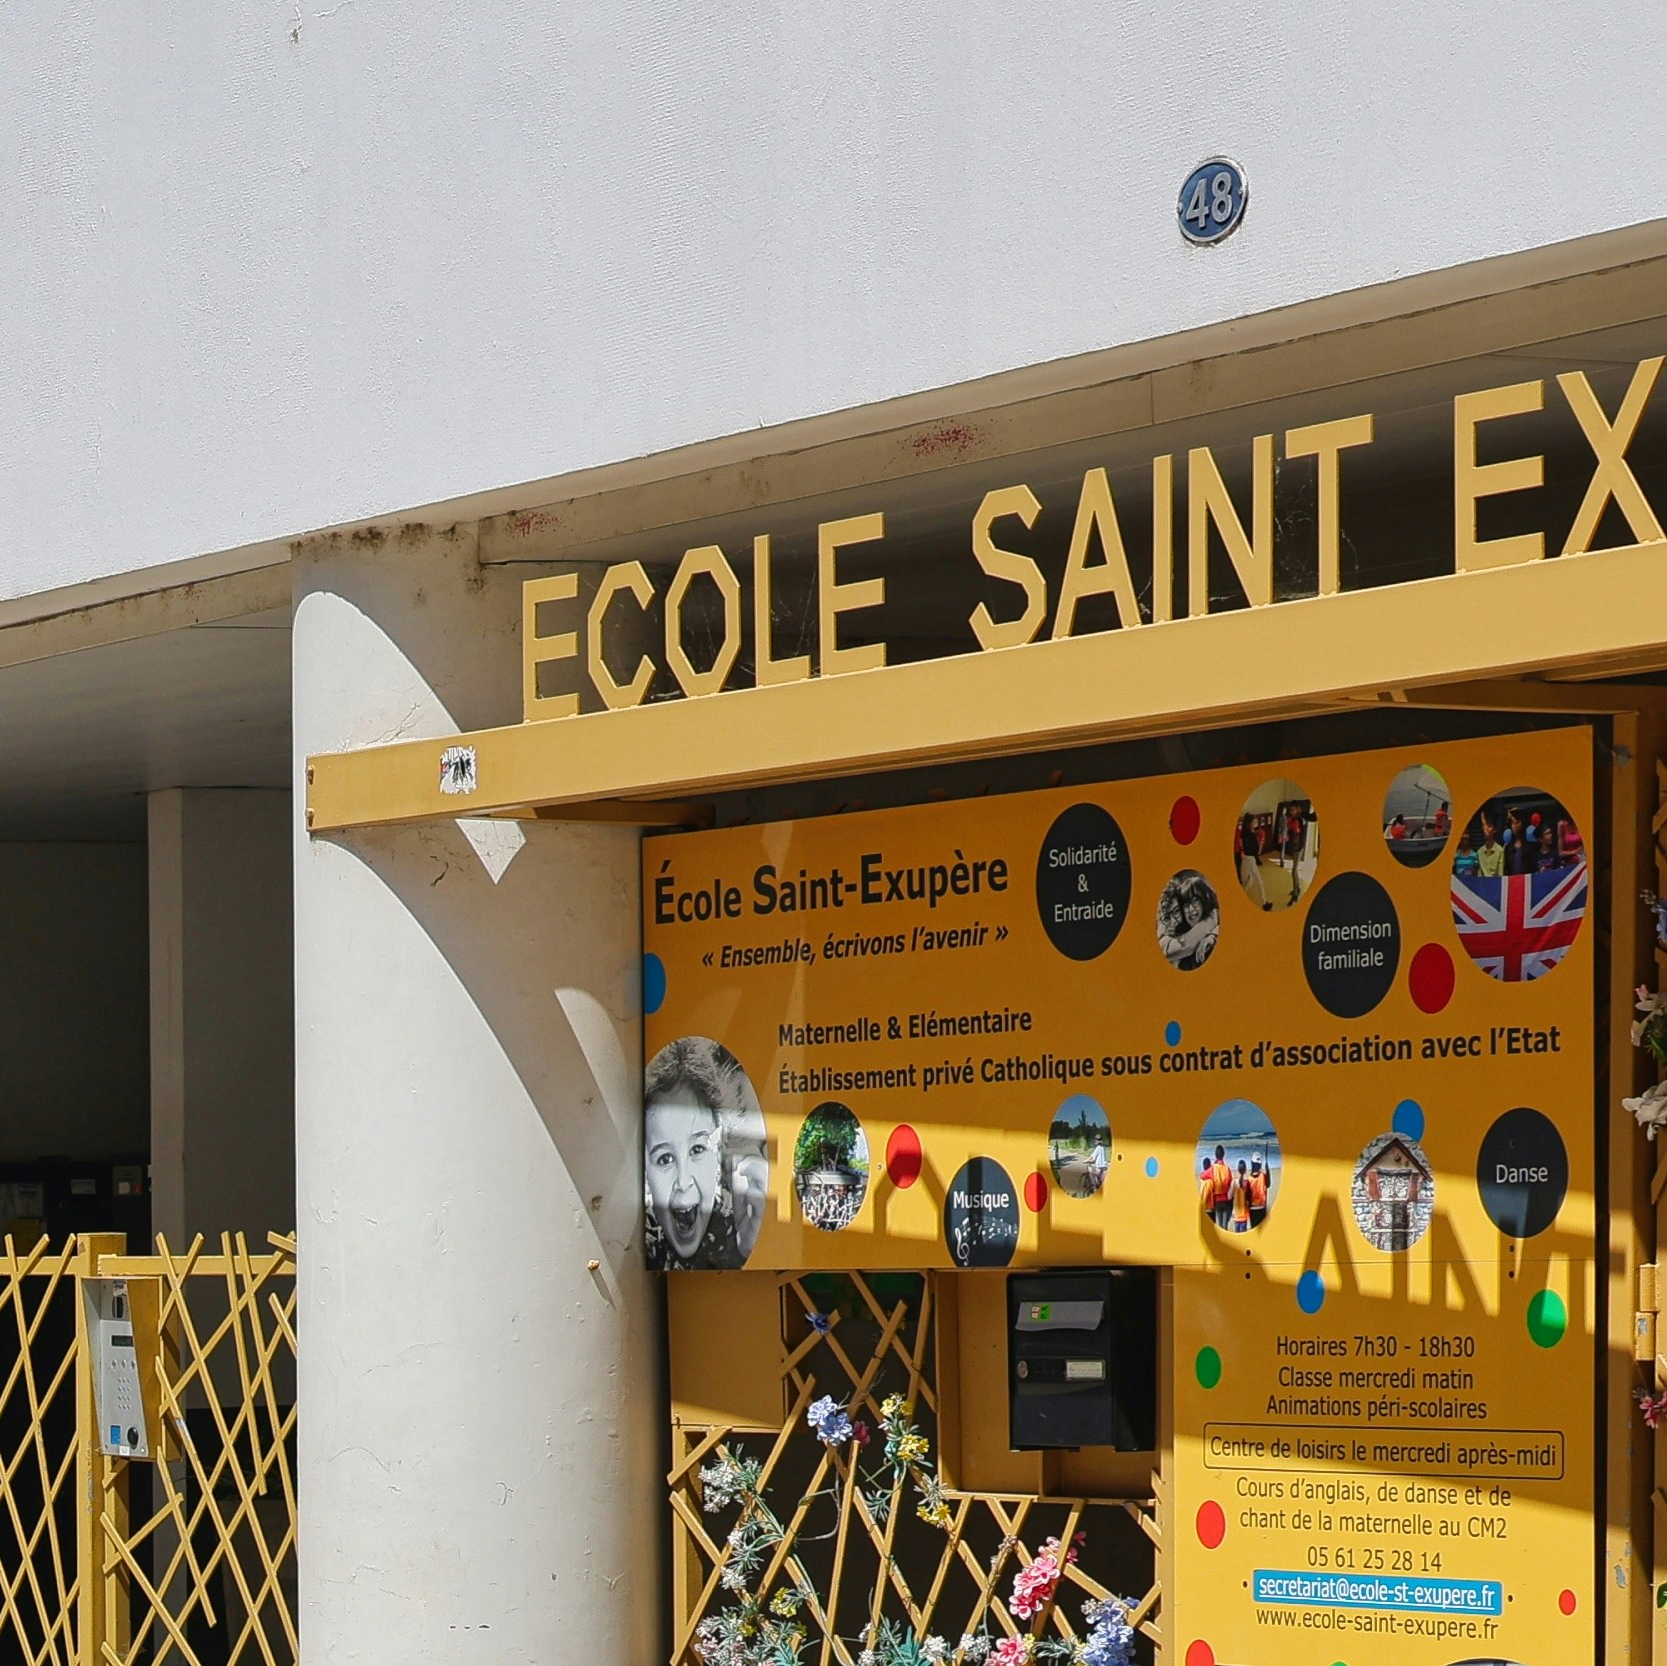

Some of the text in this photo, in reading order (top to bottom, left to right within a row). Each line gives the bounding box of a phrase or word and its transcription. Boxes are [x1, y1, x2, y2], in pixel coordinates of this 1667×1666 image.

[1185, 171, 1234, 229] 48
[522, 512, 888, 724] ECOLE
[967, 413, 1374, 653] SAINT
[1048, 841, 1118, 868] Solidarité
[653, 848, 1009, 925] École Saint-Exupère
[1077, 874, 1089, 893] &
[1053, 901, 1114, 923] Entraide
[1309, 920, 1392, 944] Dimension
[719, 938, 817, 969] Ensemble,
[822, 931, 906, 961] écrivons
[1317, 947, 1385, 971] familiale
[777, 1008, 1033, 1048] Maternelle & Elémentaire
[777, 1062, 917, 1095] Établissement
[922, 1058, 975, 1092] privé
[980, 1052, 1095, 1084] Catholique
[1101, 1051, 1153, 1075] sous
[1159, 1042, 1243, 1073] contrat
[1421, 1030, 1482, 1058] avec
[1495, 1163, 1549, 1185] Danse
[952, 1189, 1010, 1214] Musique
[1275, 1335, 1348, 1358] Horaires
[1353, 1335, 1398, 1358] 7h30
[1418, 1335, 1476, 1358] 18h30
[1277, 1366, 1474, 1390] Classe mercredi matin
[1266, 1394, 1488, 1422] Animations péri-scolaires
[1210, 1436, 1557, 1469] Centre de loisirs le mercredi après-midi
[1236, 1476, 1285, 1500] Cours
[1377, 1481, 1399, 1504] de
[1404, 1482, 1460, 1506] danse
[1464, 1485, 1484, 1506] et
[1488, 1483, 1512, 1508] de
[1239, 1507, 1508, 1539] chant de la maternelle au CM2
[1307, 1545, 1443, 1573] 05 61 25 28 14
[1259, 1574, 1496, 1611] secretariat@ecole-st-exupere.fr
[1255, 1606, 1499, 1642] www.ecole-saint-exupere.fr
